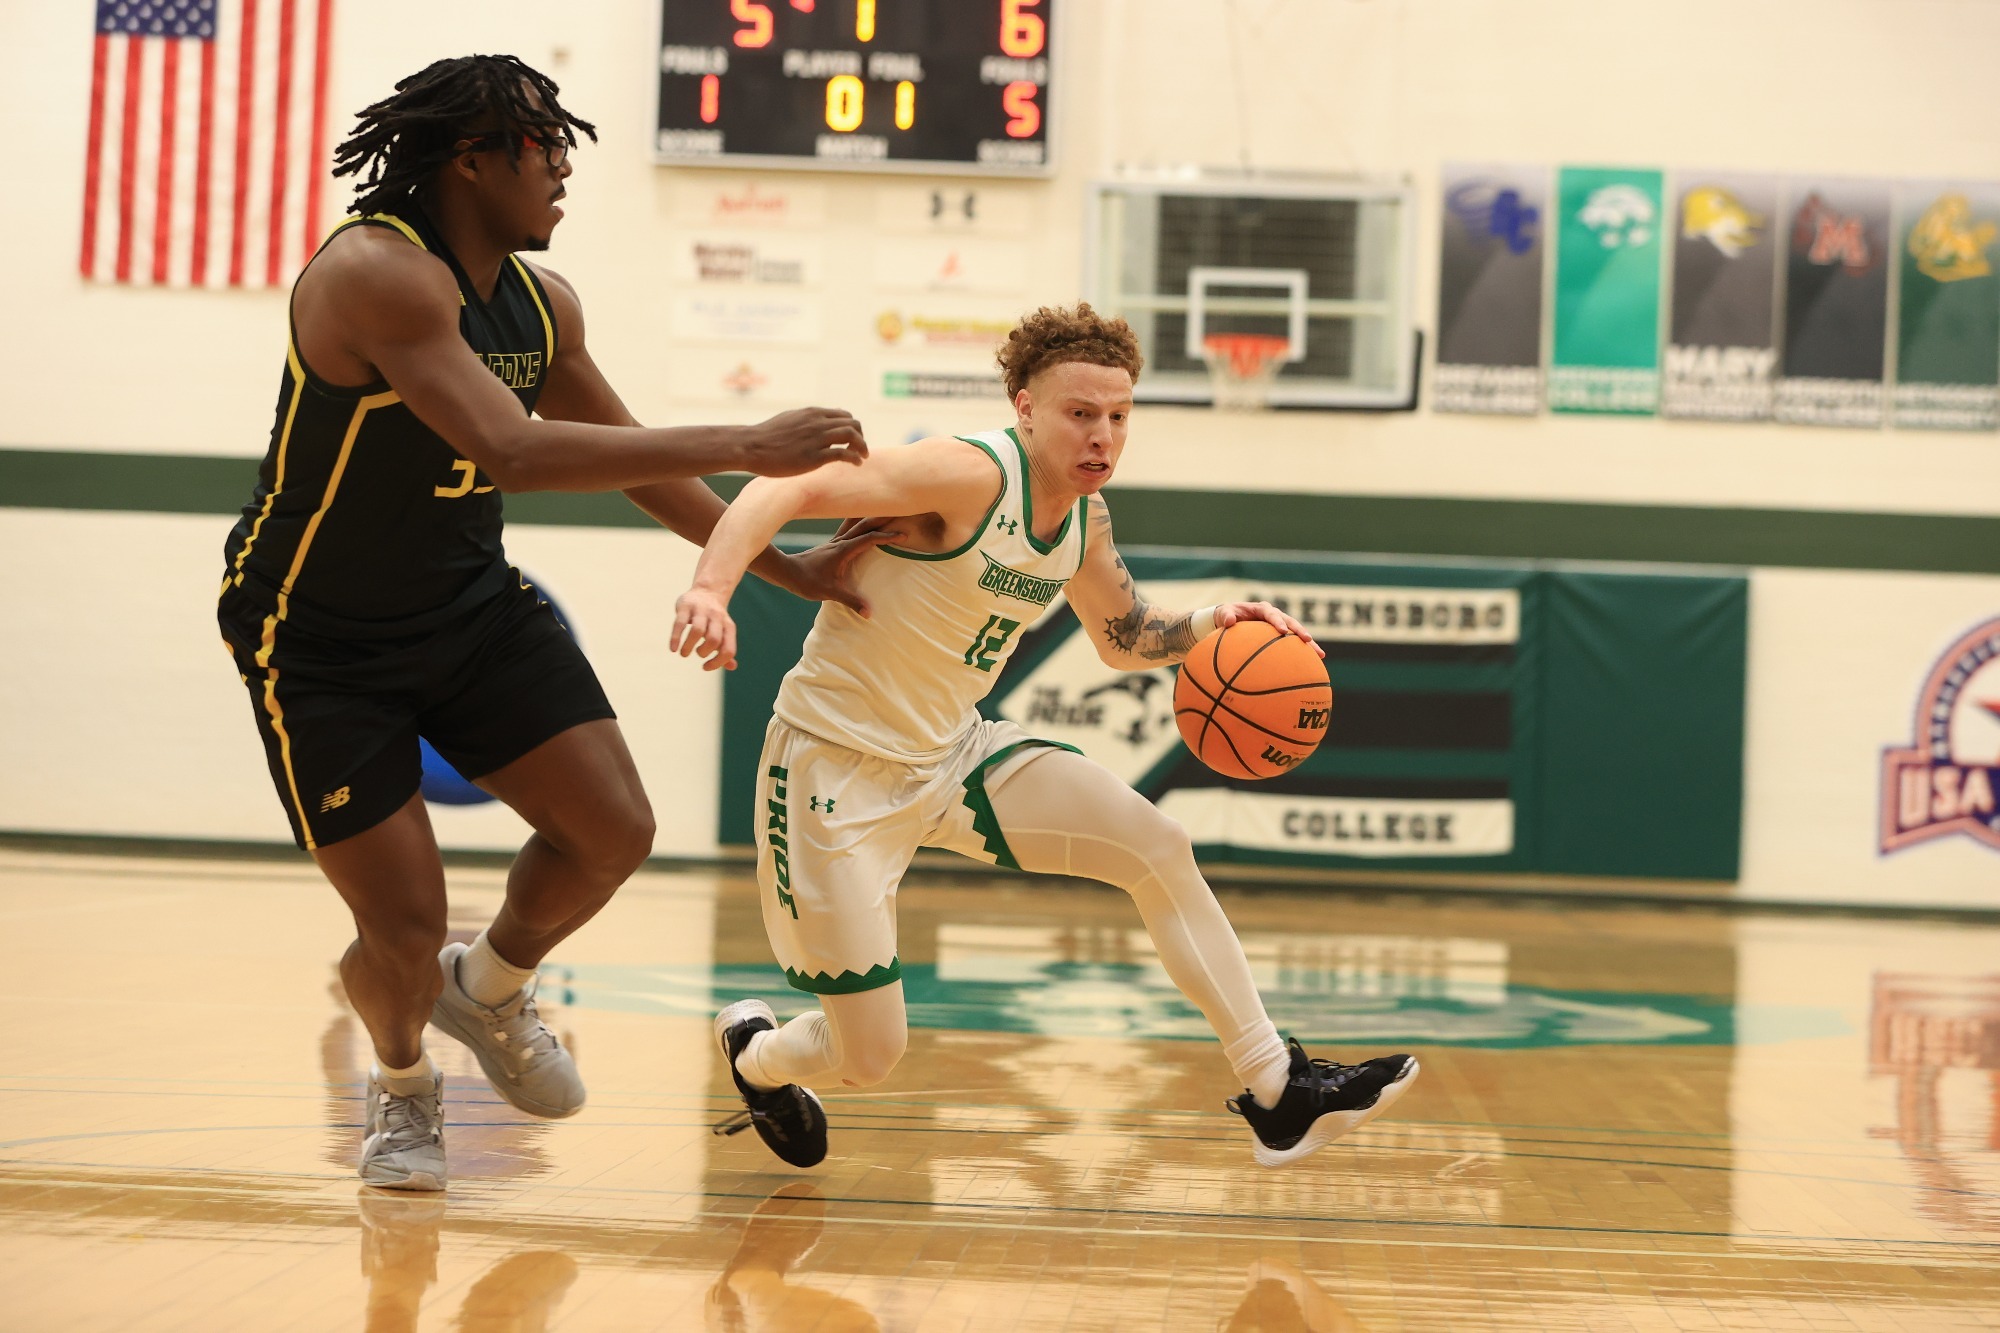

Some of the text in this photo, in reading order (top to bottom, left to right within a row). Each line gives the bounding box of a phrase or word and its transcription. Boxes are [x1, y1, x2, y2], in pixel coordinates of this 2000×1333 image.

[730, 0, 774, 48] 5
[999, 0, 1046, 58] 6
[700, 73, 720, 124] 1
[1002, 79, 1041, 138] 5
[963, 613, 1021, 673] 12
[1283, 809, 1455, 842] COLLEGE
[1900, 765, 1996, 830] USA
[767, 765, 799, 920] PRIDE
